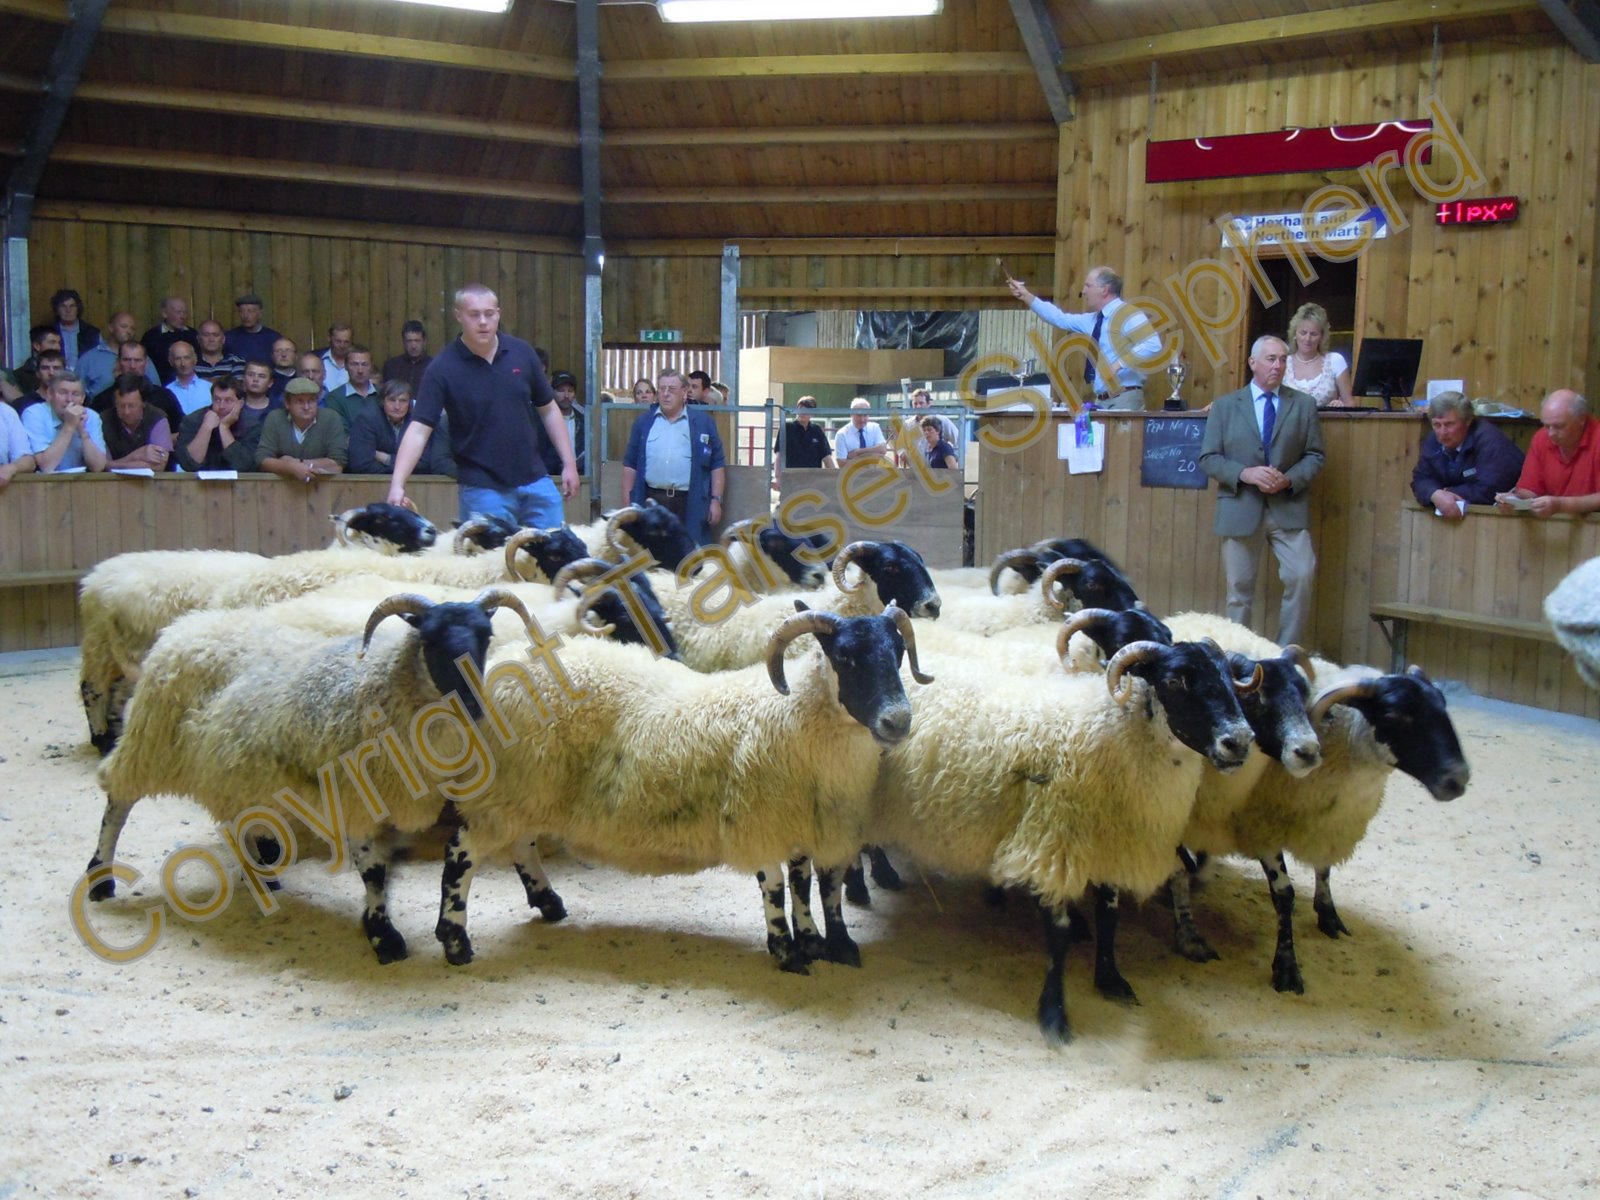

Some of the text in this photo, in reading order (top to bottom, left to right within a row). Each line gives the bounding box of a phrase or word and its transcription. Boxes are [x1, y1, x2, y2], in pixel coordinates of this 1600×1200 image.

[1255, 212, 1348, 229] Hexham and
[1255, 223, 1368, 242] Northern Marts
[1177, 459, 1196, 473] 20
